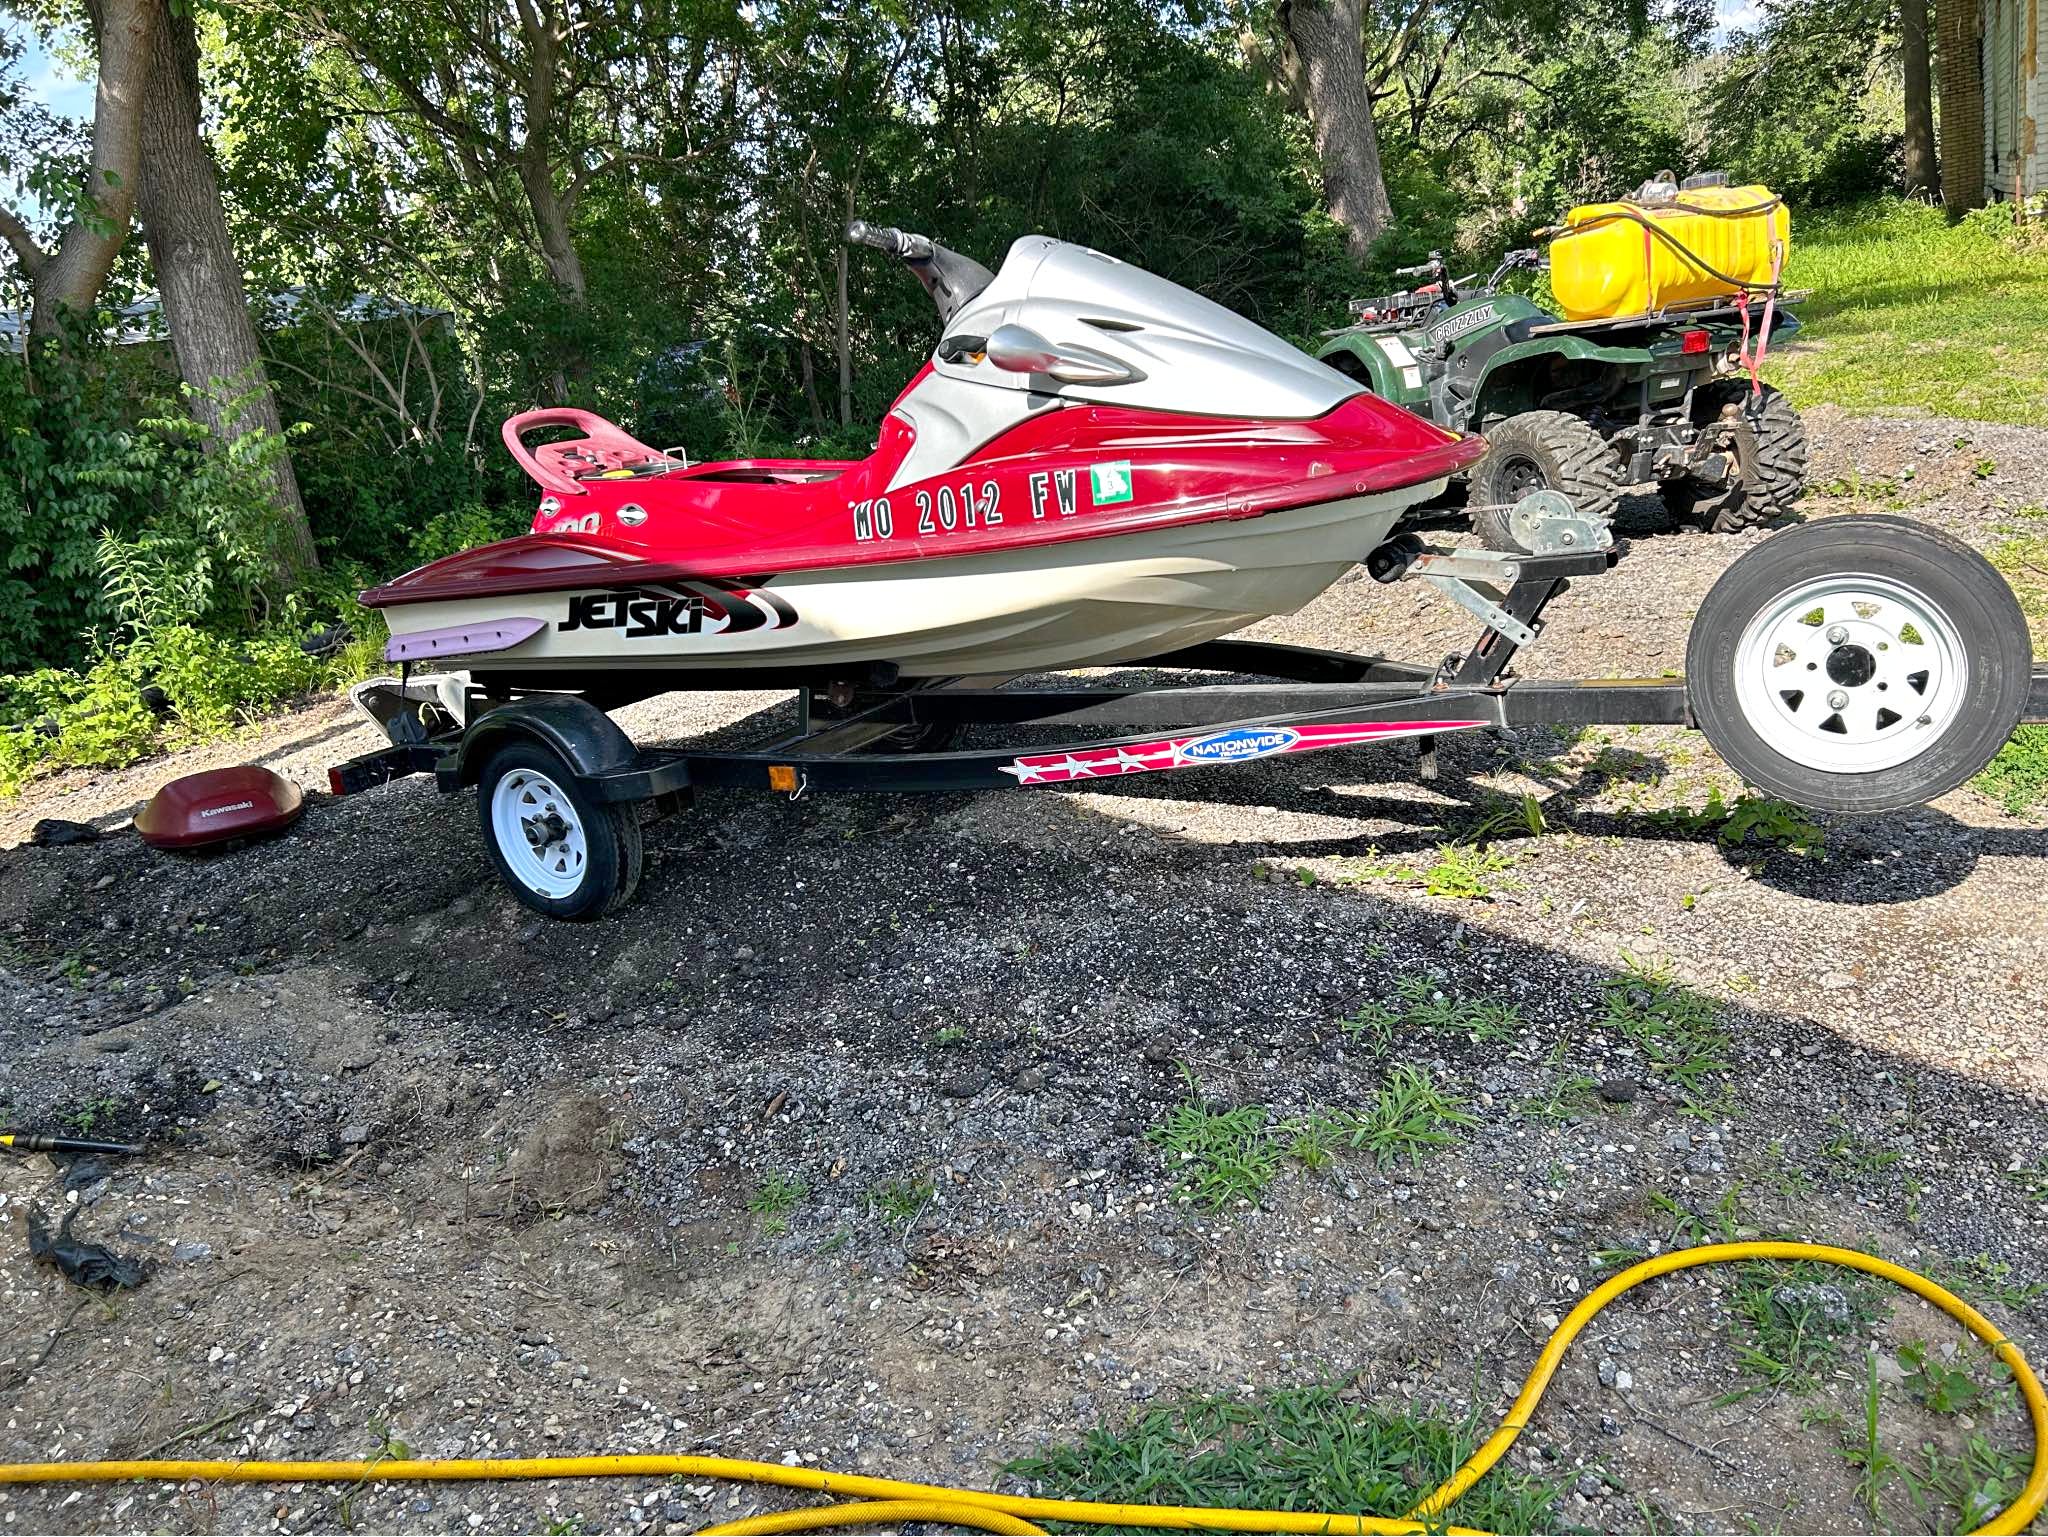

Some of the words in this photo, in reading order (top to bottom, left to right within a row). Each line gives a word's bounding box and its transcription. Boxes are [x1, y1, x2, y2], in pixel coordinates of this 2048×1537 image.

[1435, 304, 1493, 341] GRIZZLY
[854, 498, 893, 540] MO
[915, 480, 1003, 533] 2012
[1029, 469, 1077, 518] FW
[1192, 734, 1285, 756] NATIONWIDE
[201, 800, 254, 819] Kawasaki
